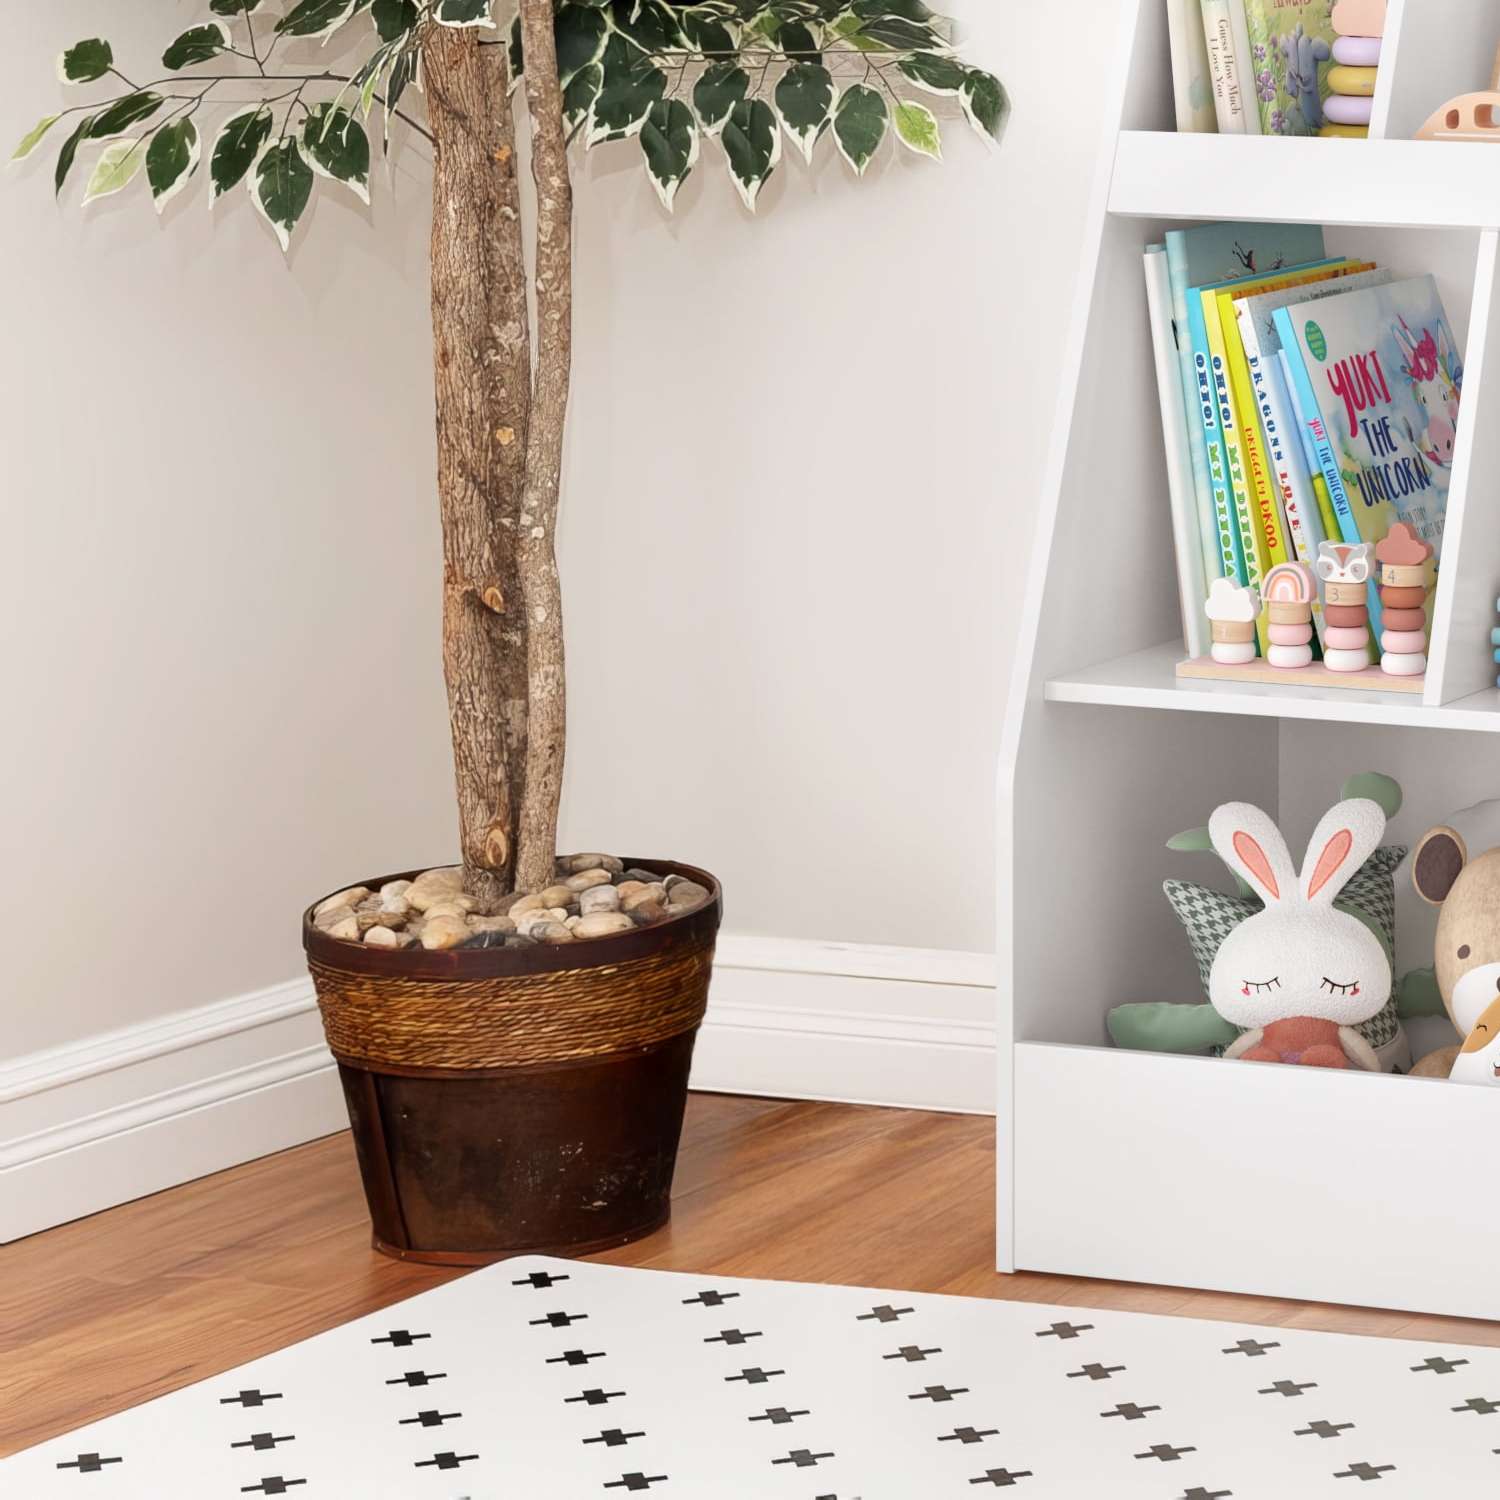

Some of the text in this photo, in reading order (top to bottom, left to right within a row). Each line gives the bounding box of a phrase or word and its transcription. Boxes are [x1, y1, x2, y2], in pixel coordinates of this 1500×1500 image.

[1210, 47, 1220, 72] Love
[1215, 78, 1225, 98] You
[1217, 19, 1242, 116] Guess How Much
[1249, 356, 1284, 461] DRAGONS
[1326, 350, 1392, 438] YUKI
[1360, 416, 1398, 458] THE
[1208, 444, 1223, 480] MY
[1227, 445, 1243, 482] MY
[1307, 417, 1350, 517] YUKI THE UNICORN
[1356, 451, 1431, 507] UNICORN
[1260, 500, 1278, 548] DROO
[1332, 588, 1340, 602] 3
[1387, 569, 1396, 584] 4
